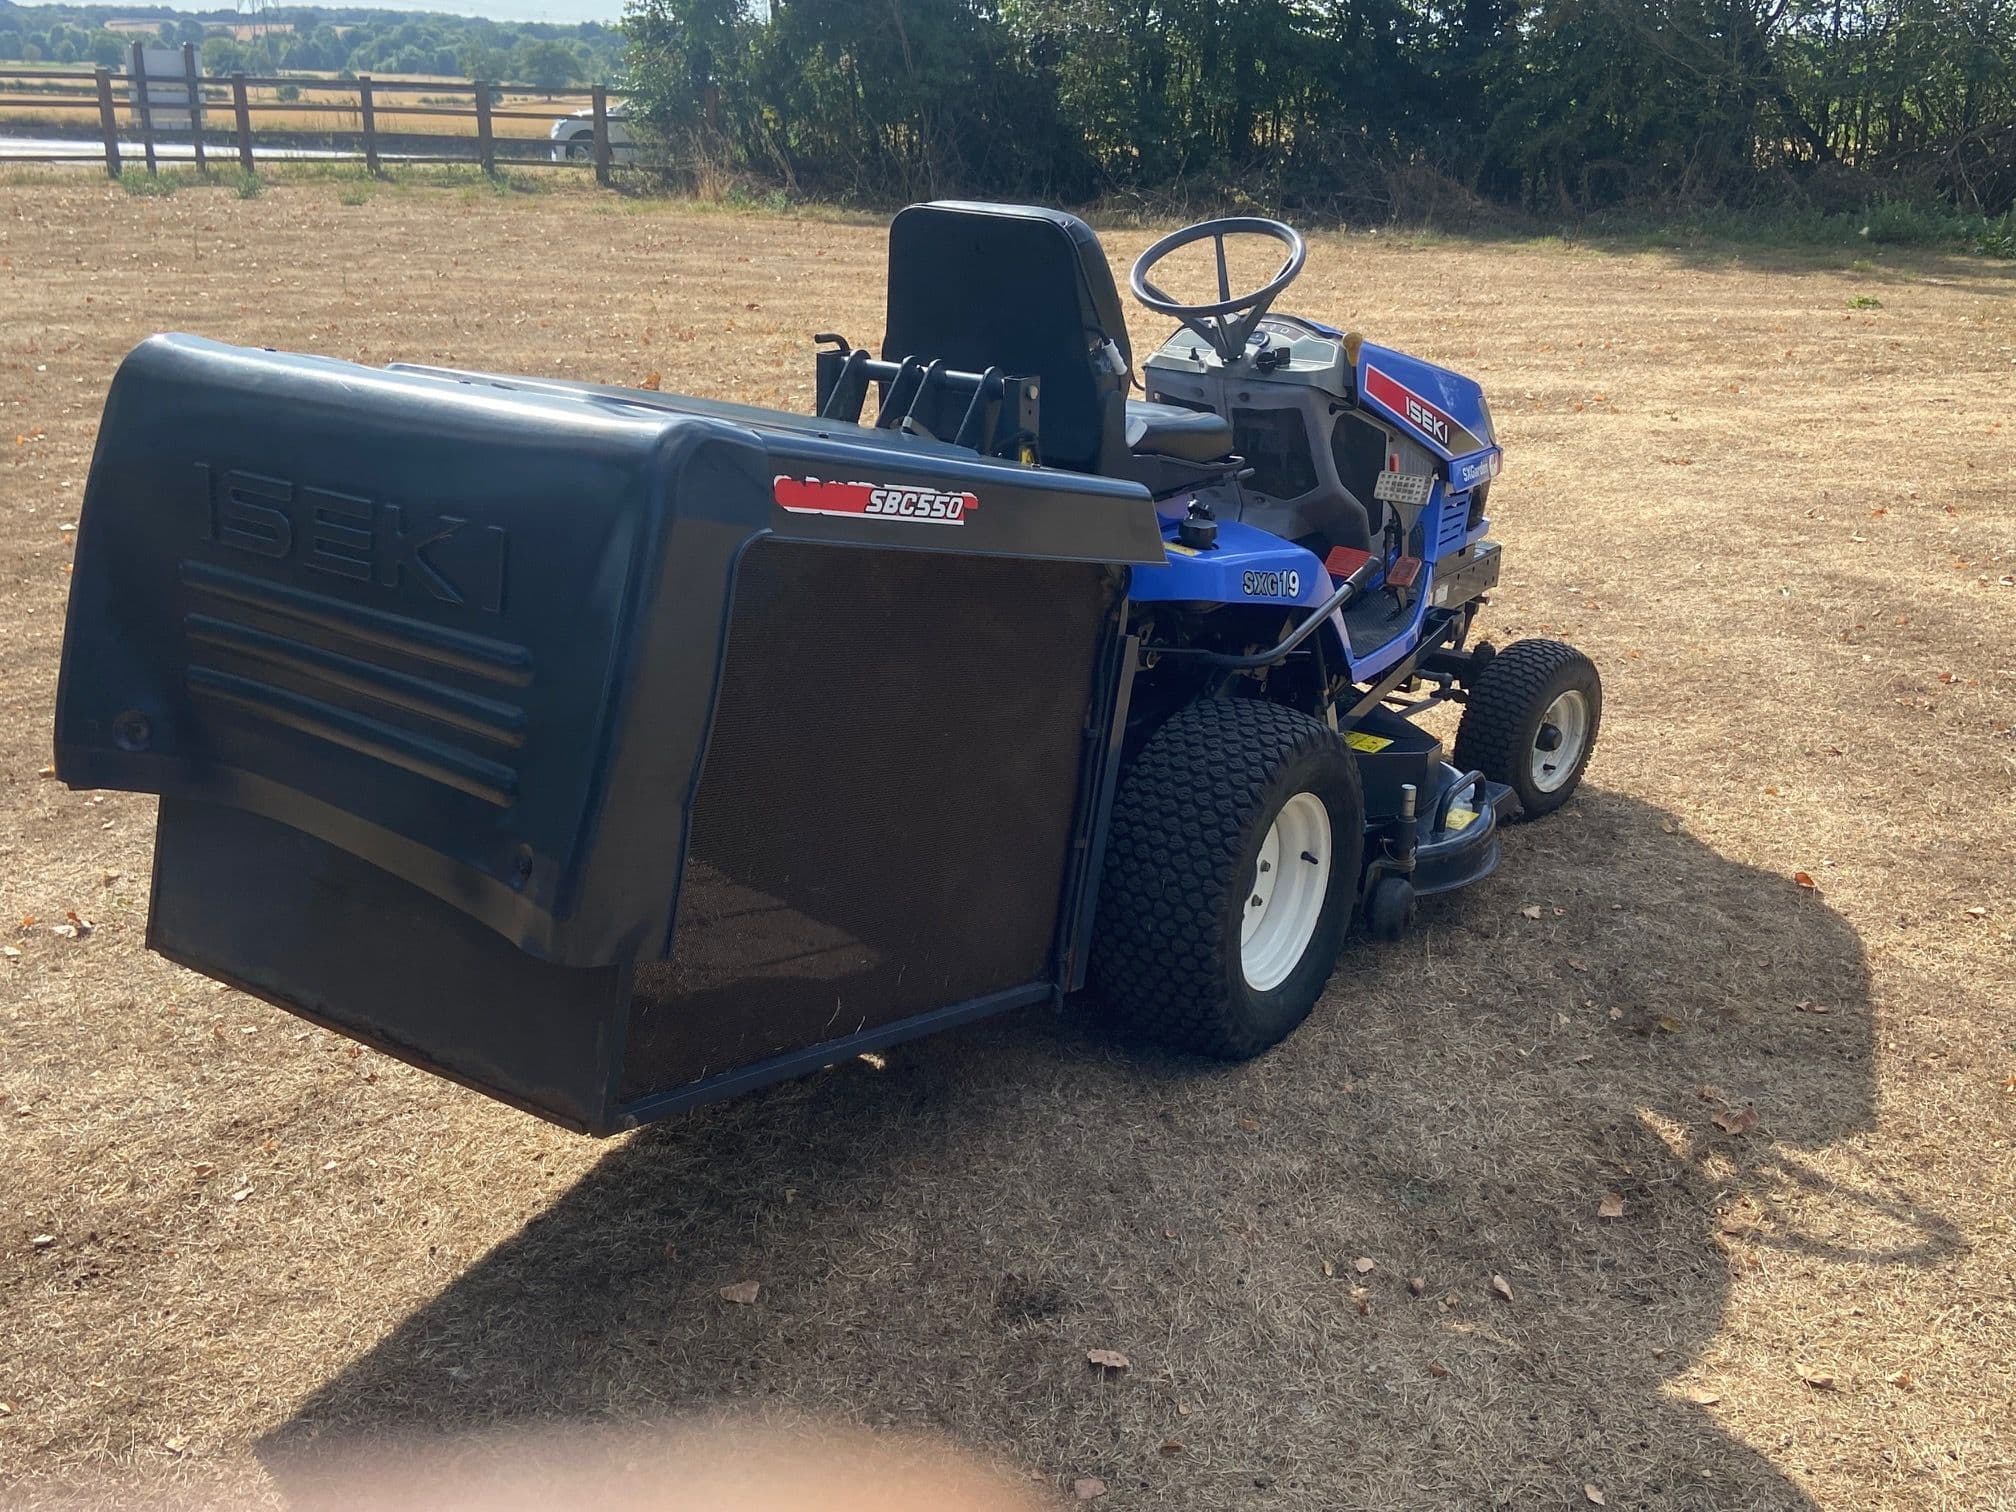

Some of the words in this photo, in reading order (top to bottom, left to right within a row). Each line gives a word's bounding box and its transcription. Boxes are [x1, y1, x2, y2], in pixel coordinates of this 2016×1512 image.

[1405, 396, 1448, 444] ISEKI
[865, 489, 964, 519] SBC550
[193, 461, 509, 613] ISEKI
[1242, 569, 1300, 598] SXG19
